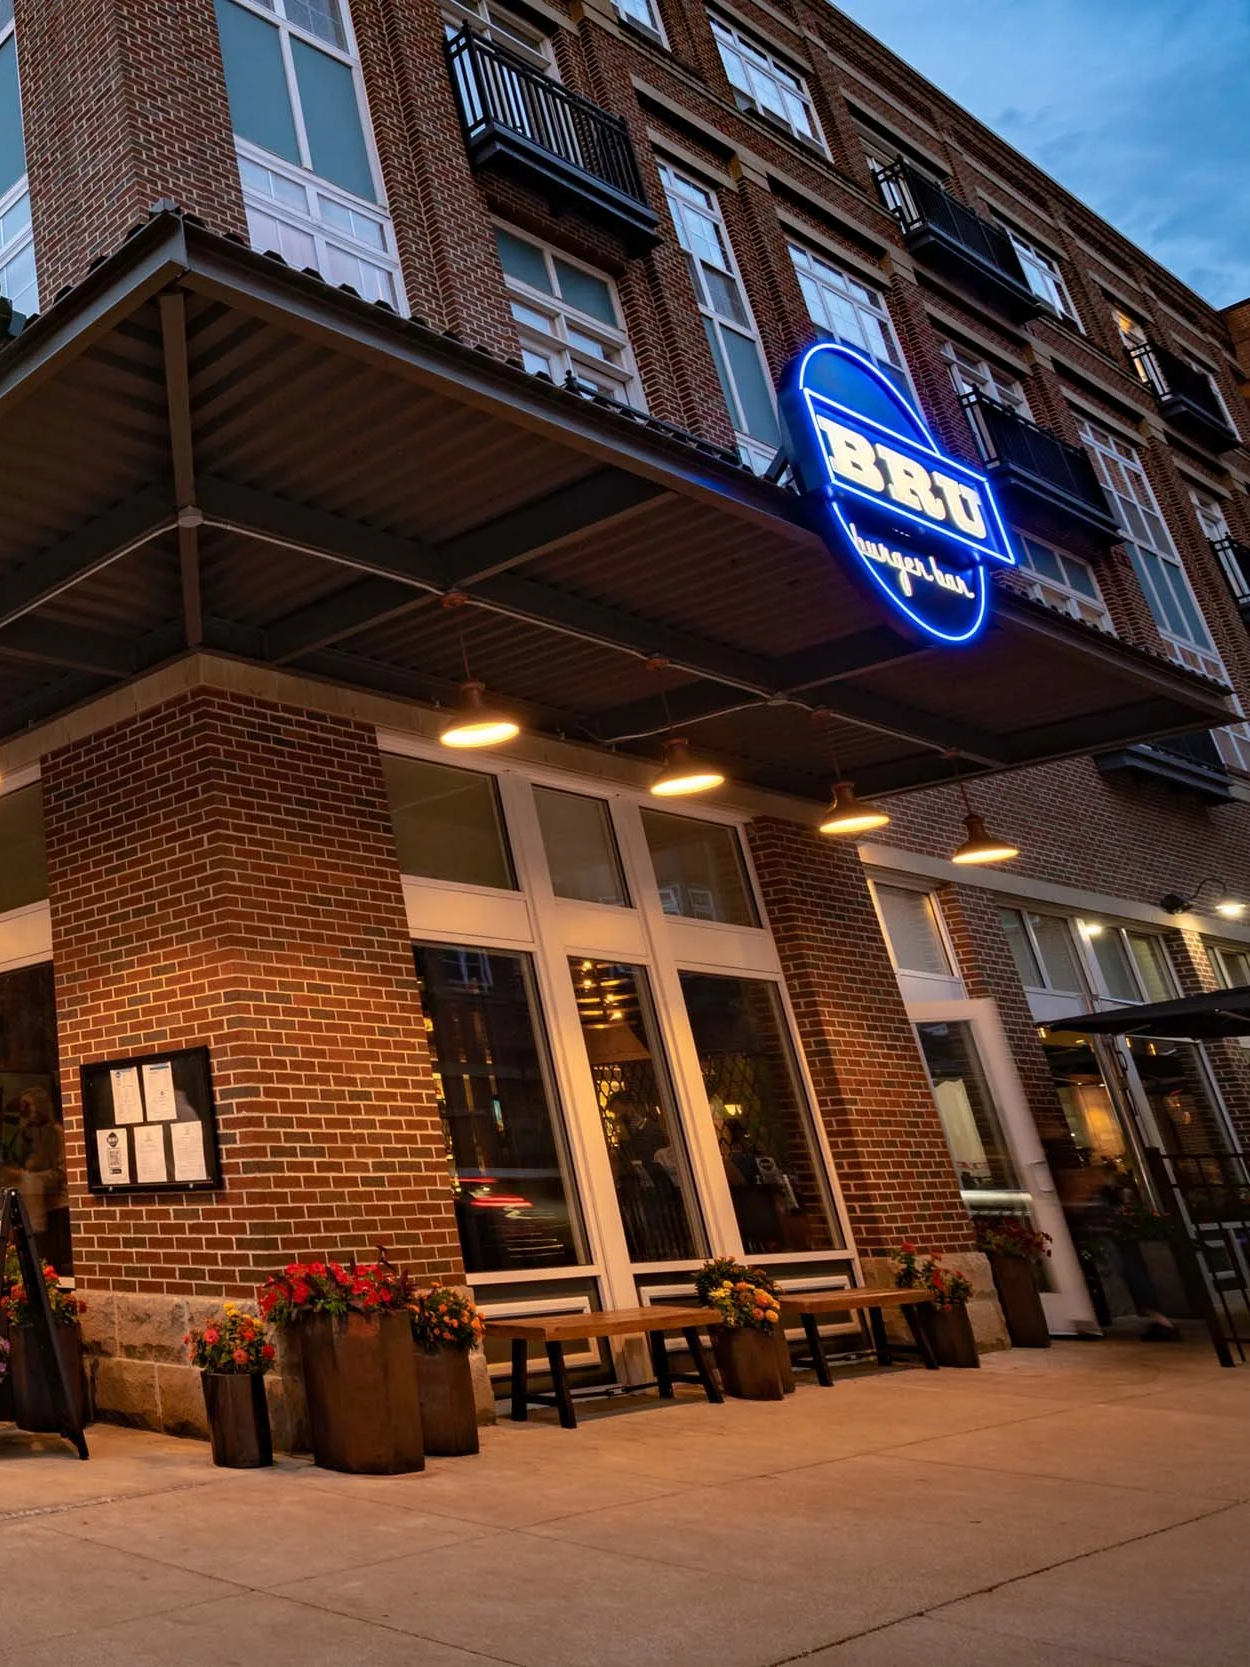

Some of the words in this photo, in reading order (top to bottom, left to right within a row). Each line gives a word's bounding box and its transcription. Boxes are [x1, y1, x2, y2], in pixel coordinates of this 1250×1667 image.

[815, 414, 987, 539] BRU
[849, 523, 934, 597] burger
[929, 556, 976, 599] bar
